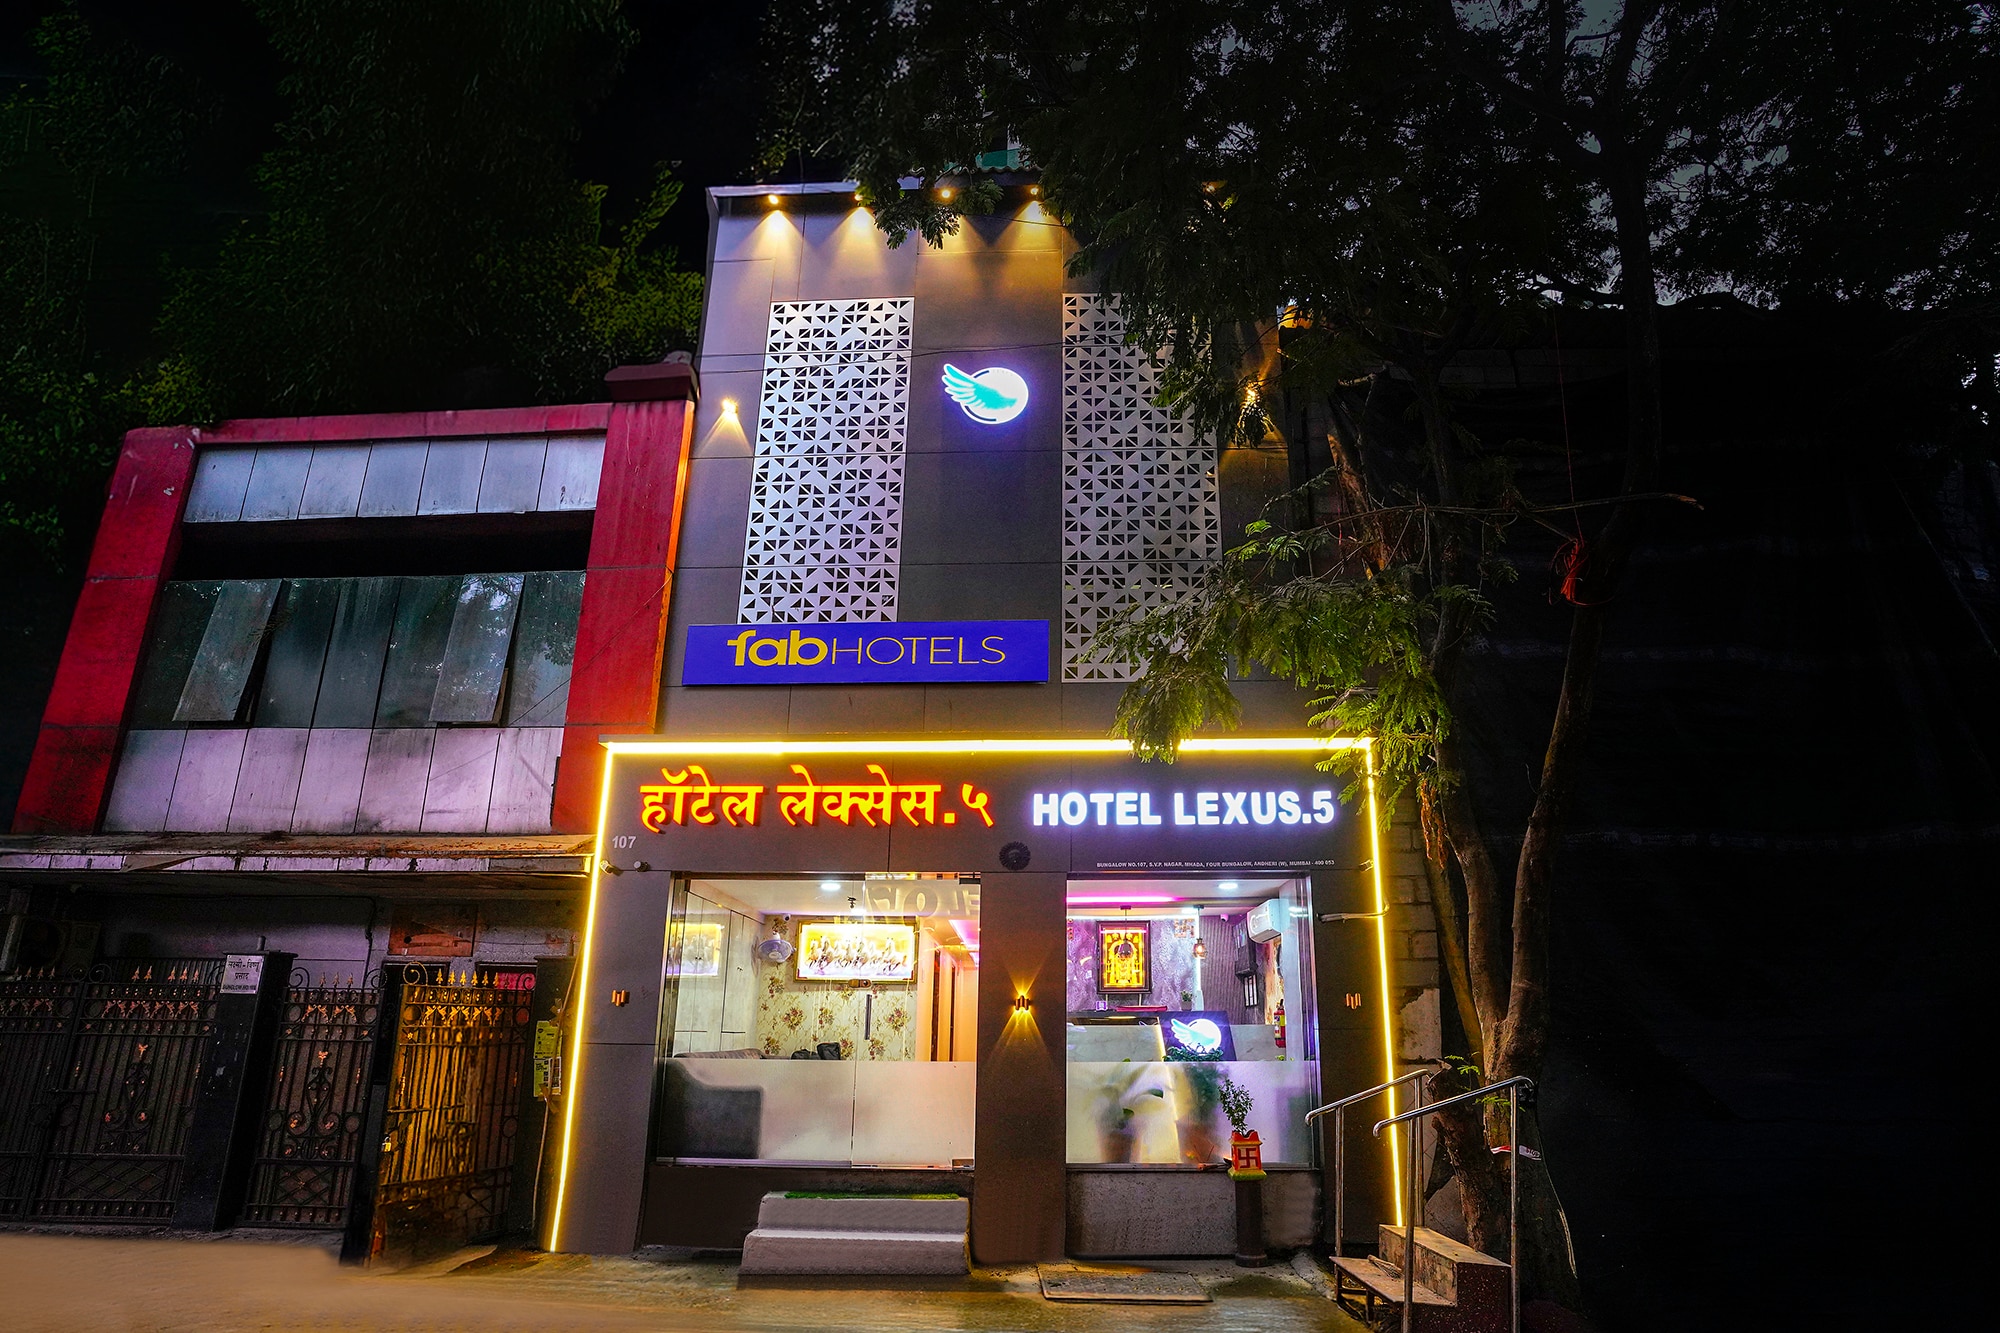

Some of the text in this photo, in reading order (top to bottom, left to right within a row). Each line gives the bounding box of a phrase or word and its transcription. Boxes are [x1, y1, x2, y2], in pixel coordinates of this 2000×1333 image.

[640, 765, 764, 833] हॉटेल
[1033, 790, 1335, 826] HOTEL LEXUS.5
[612, 835, 637, 849] 107
